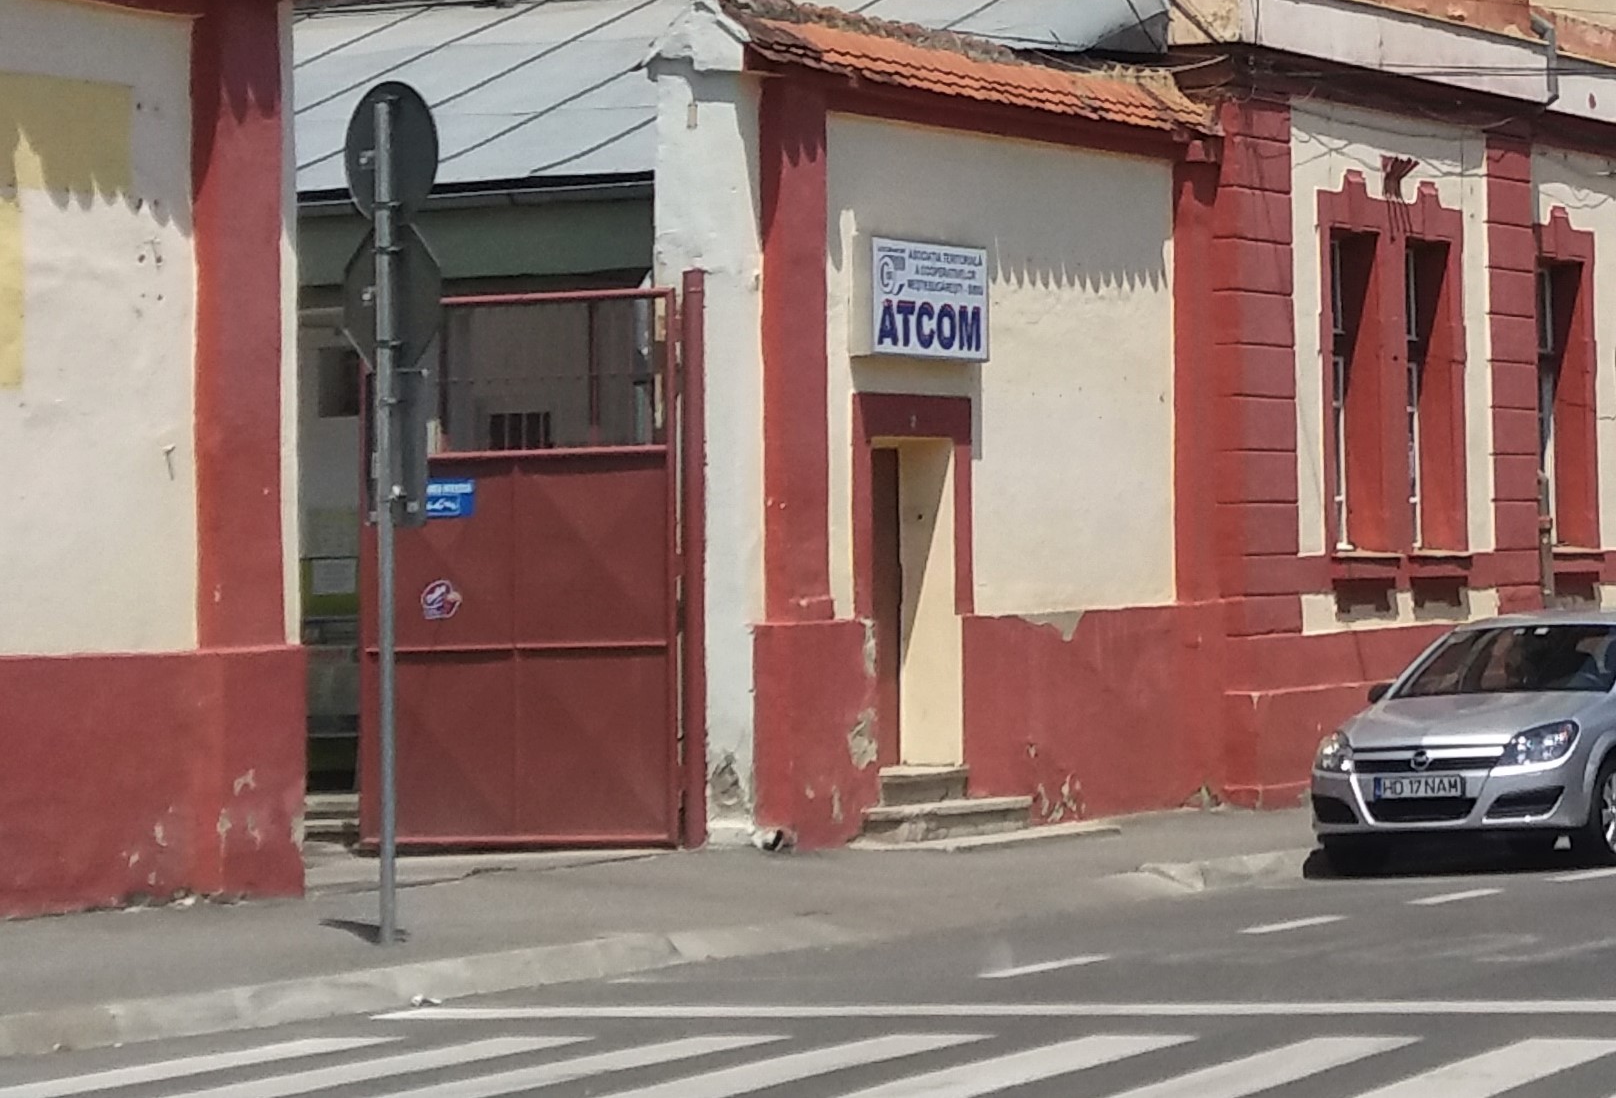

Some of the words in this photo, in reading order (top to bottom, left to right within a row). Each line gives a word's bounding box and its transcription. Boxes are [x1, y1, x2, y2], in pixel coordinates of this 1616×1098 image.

[877, 299, 982, 352] ATCOM
[1383, 780, 1404, 795] HD
[1409, 779, 1421, 794] 17
[1425, 777, 1458, 794] NAM
